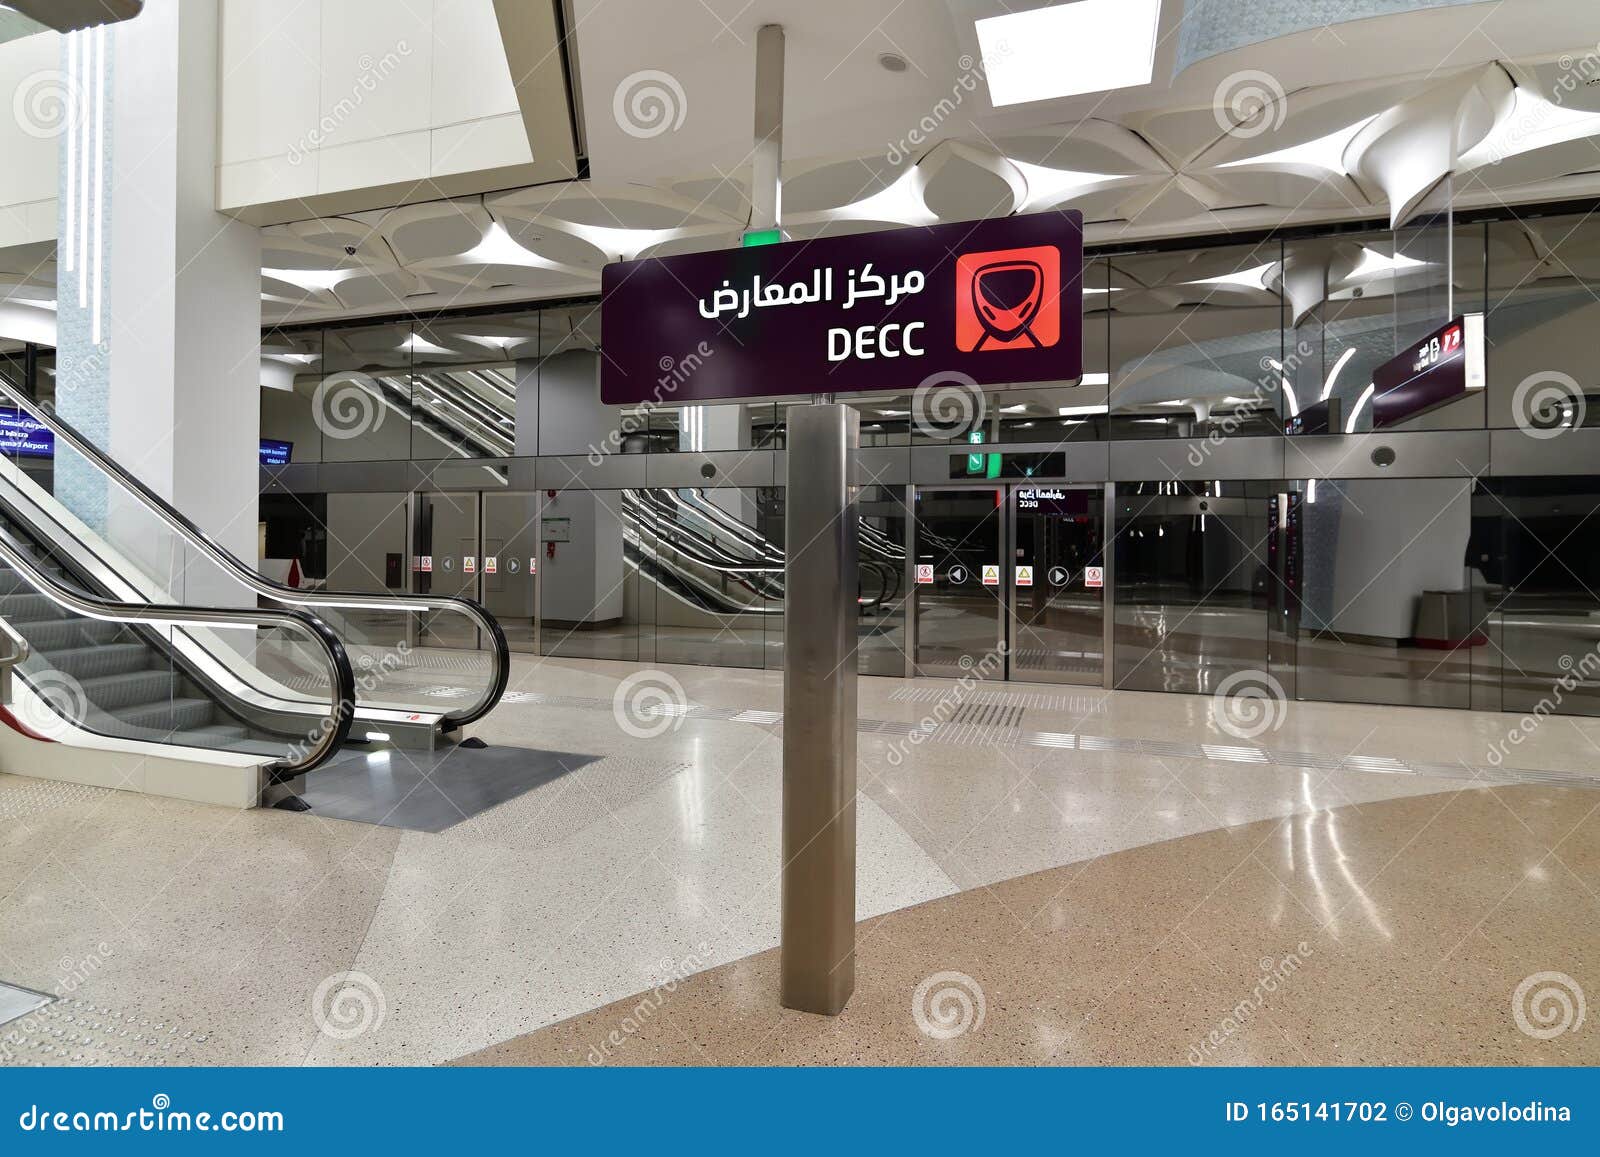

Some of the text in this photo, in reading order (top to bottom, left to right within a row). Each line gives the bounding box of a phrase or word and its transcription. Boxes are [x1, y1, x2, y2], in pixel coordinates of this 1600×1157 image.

[698, 263, 925, 319] مركز المعارض
[828, 321, 925, 362] DECC
[23, 442, 49, 450] Airport
